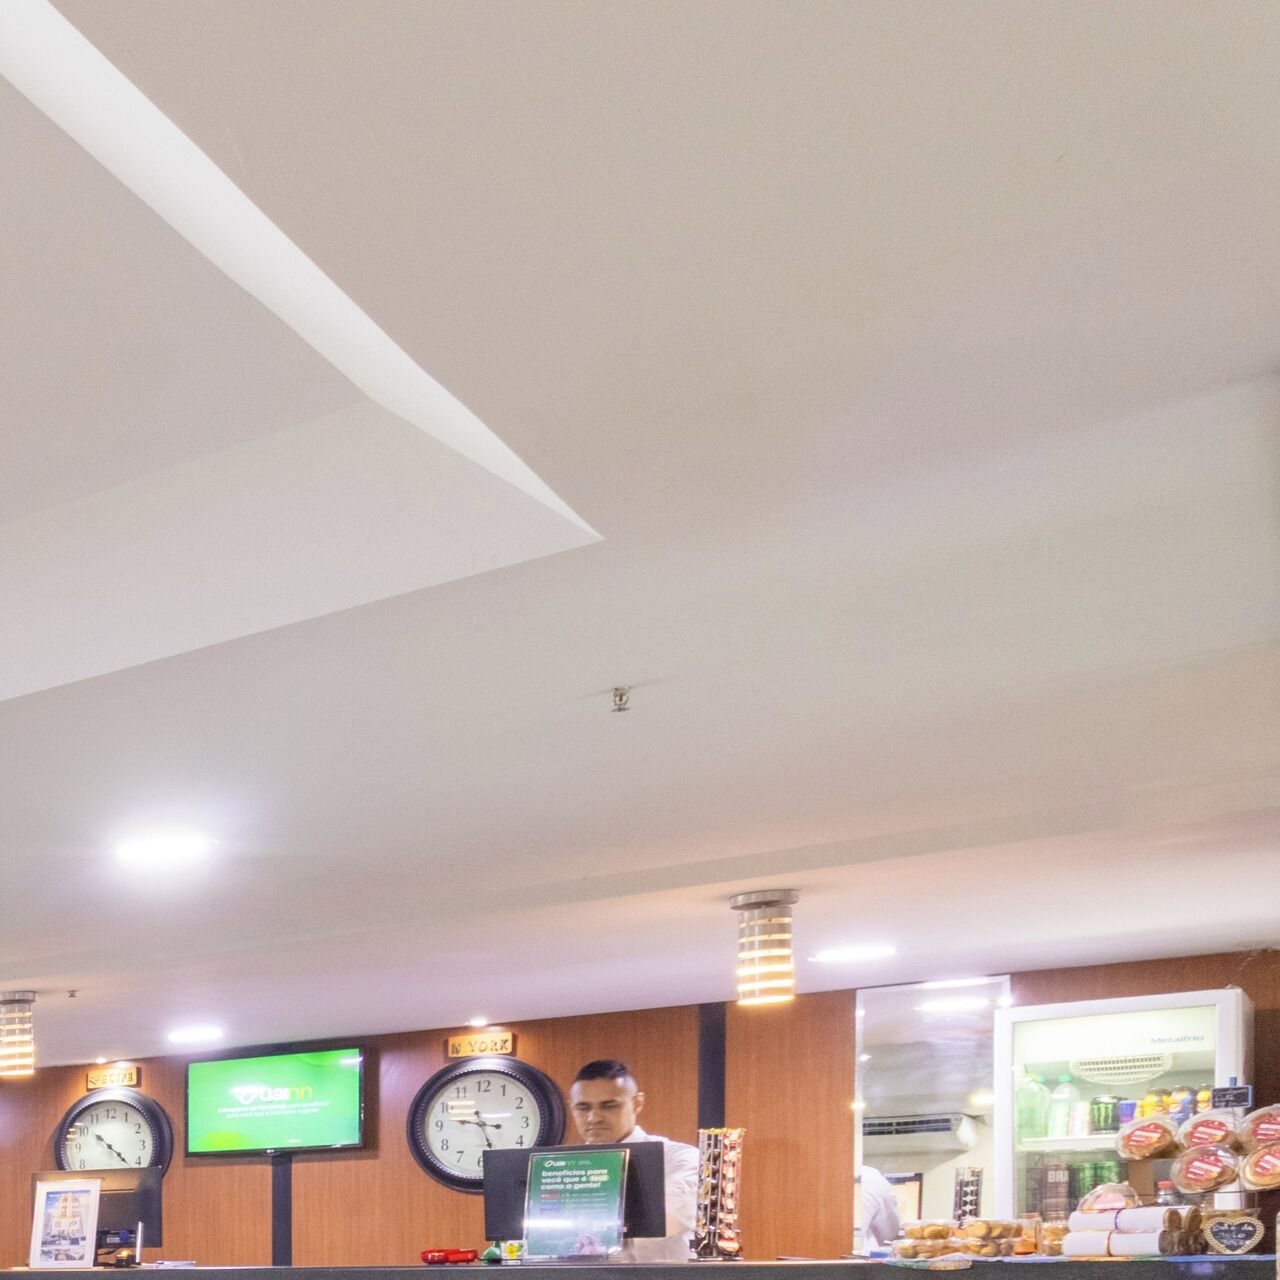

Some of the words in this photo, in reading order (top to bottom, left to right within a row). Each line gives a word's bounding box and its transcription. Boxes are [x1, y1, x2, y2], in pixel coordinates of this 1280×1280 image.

[468, 1039, 509, 1052] YORK
[455, 1086, 467, 1099] 11
[476, 1080, 491, 1093] 12
[500, 1084, 507, 1097] 1
[515, 1097, 524, 1109] 2
[90, 1113, 99, 1124] 11
[105, 1108, 117, 1119] 12
[123, 1112, 128, 1123] 1
[134, 1123, 141, 1134] 2
[435, 1120, 444, 1132] 9
[521, 1116, 530, 1129] 3
[79, 1126, 89, 1137] 10
[139, 1140, 146, 1151] 3
[440, 1139, 449, 1151] 8
[515, 1135, 525, 1147] 4
[75, 1143, 82, 1153] 9
[134, 1156, 141, 1167] 4
[456, 1151, 465, 1163] 7
[79, 1159, 86, 1169] 8
